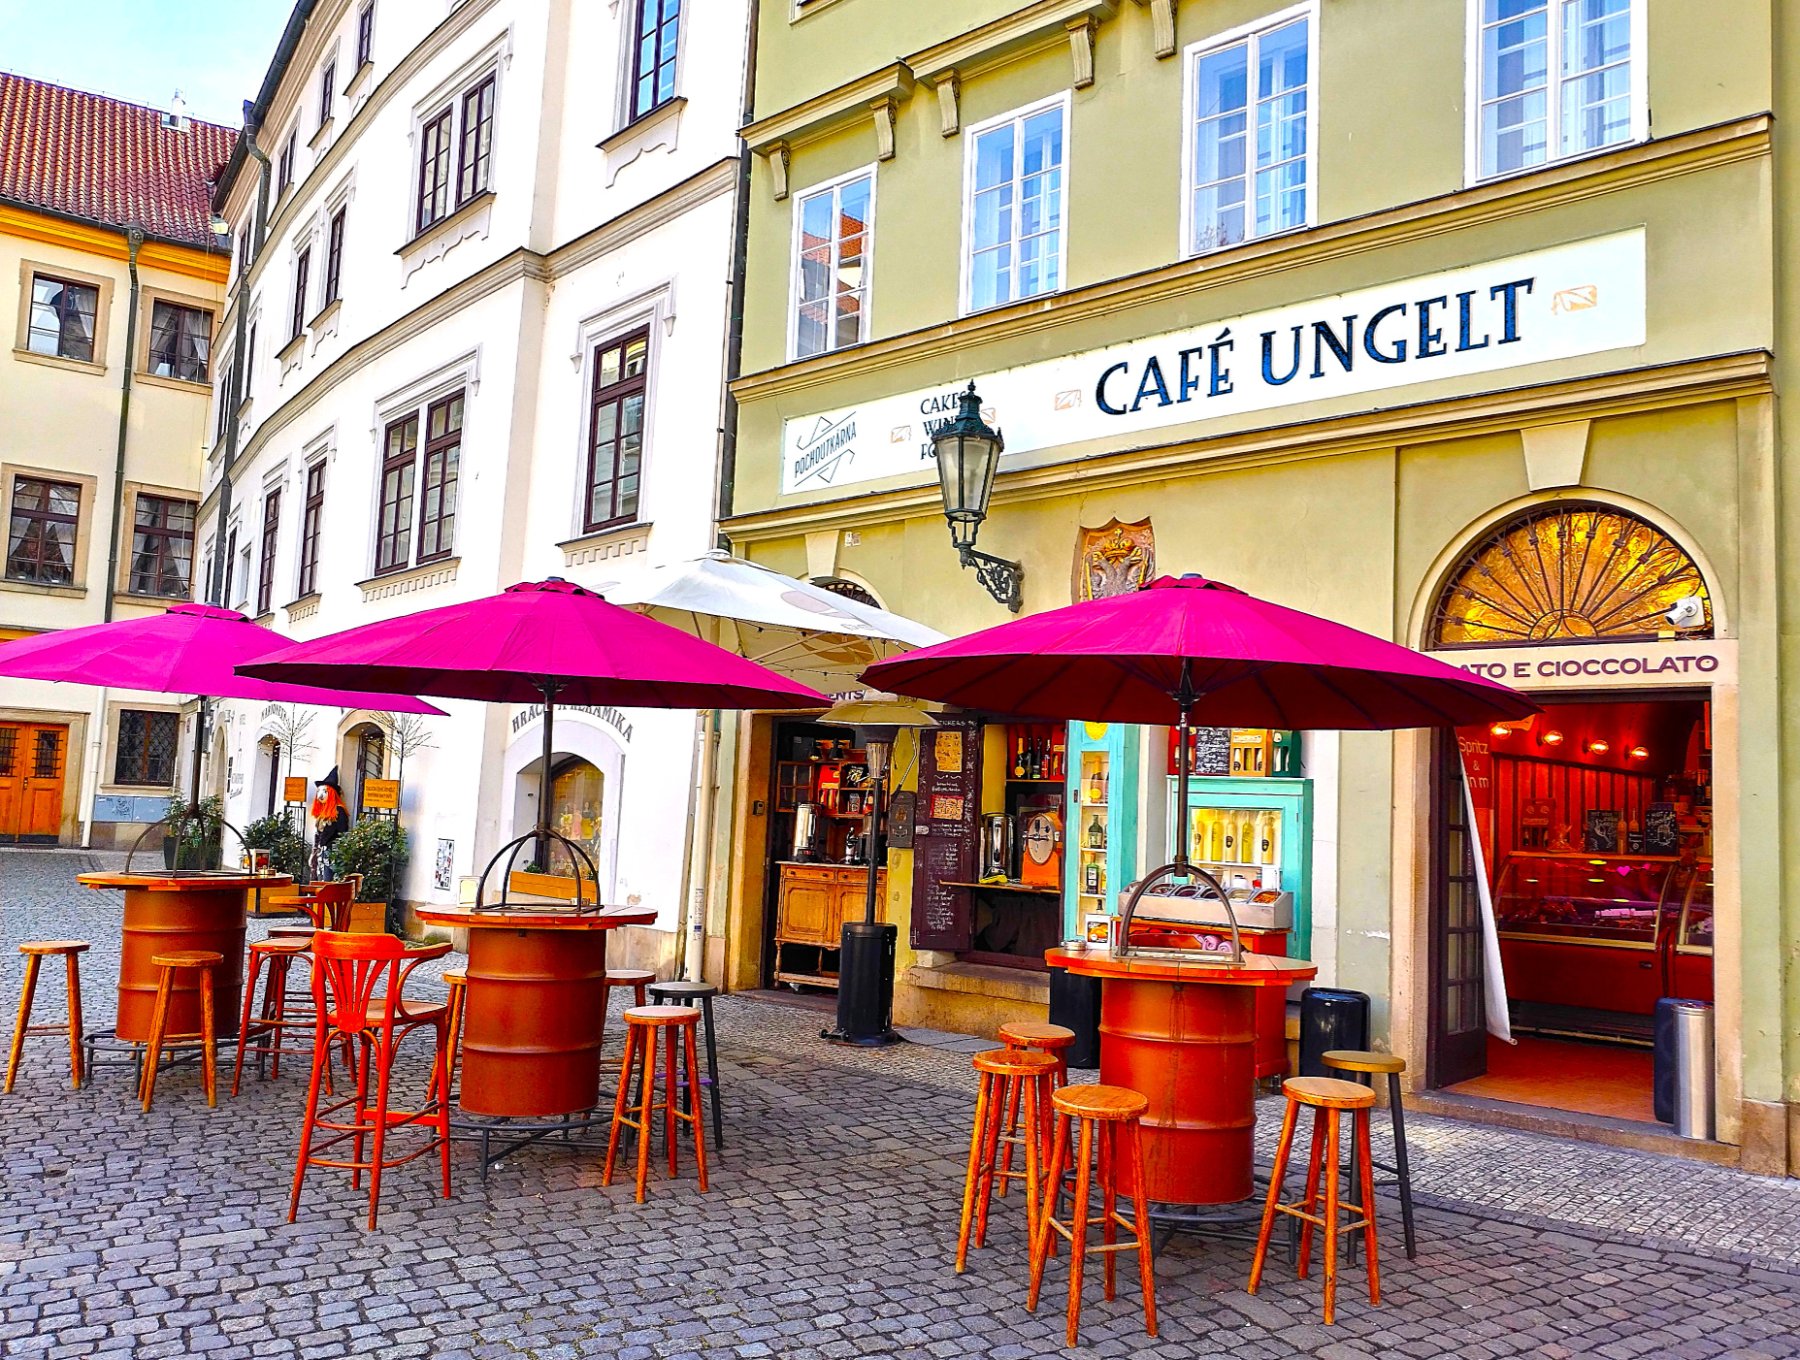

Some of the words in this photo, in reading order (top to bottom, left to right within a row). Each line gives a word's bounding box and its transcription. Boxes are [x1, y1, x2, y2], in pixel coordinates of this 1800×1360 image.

[1095, 326, 1234, 415] CAFÉ
[1259, 276, 1538, 386] UNGELT
[794, 421, 857, 478] POCHOUTKÁRNA
[1513, 662, 1531, 678] E
[1537, 655, 1719, 677] CIOCCOLATO
